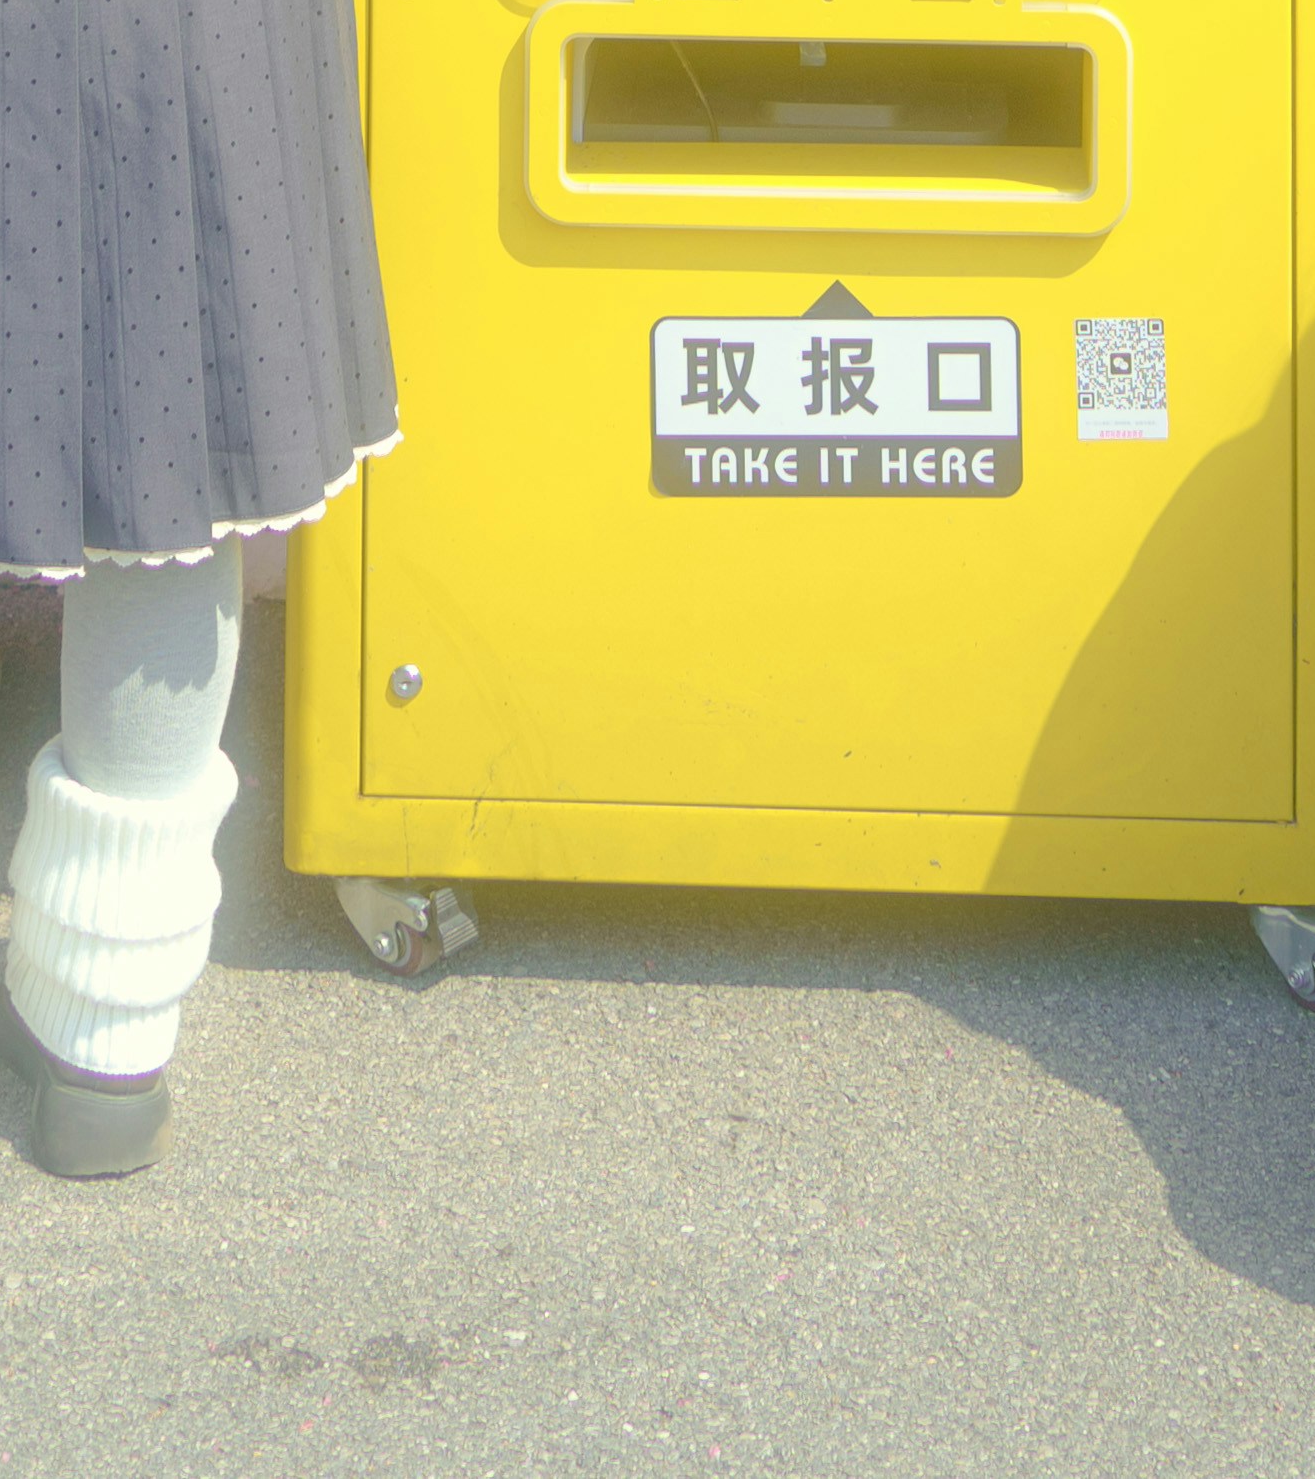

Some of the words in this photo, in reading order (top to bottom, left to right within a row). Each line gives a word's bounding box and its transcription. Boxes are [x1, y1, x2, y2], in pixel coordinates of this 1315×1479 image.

[680, 336, 992, 416] 取报口
[684, 447, 798, 483] TAKE
[819, 448, 859, 483] IT
[881, 448, 995, 484] HERE
